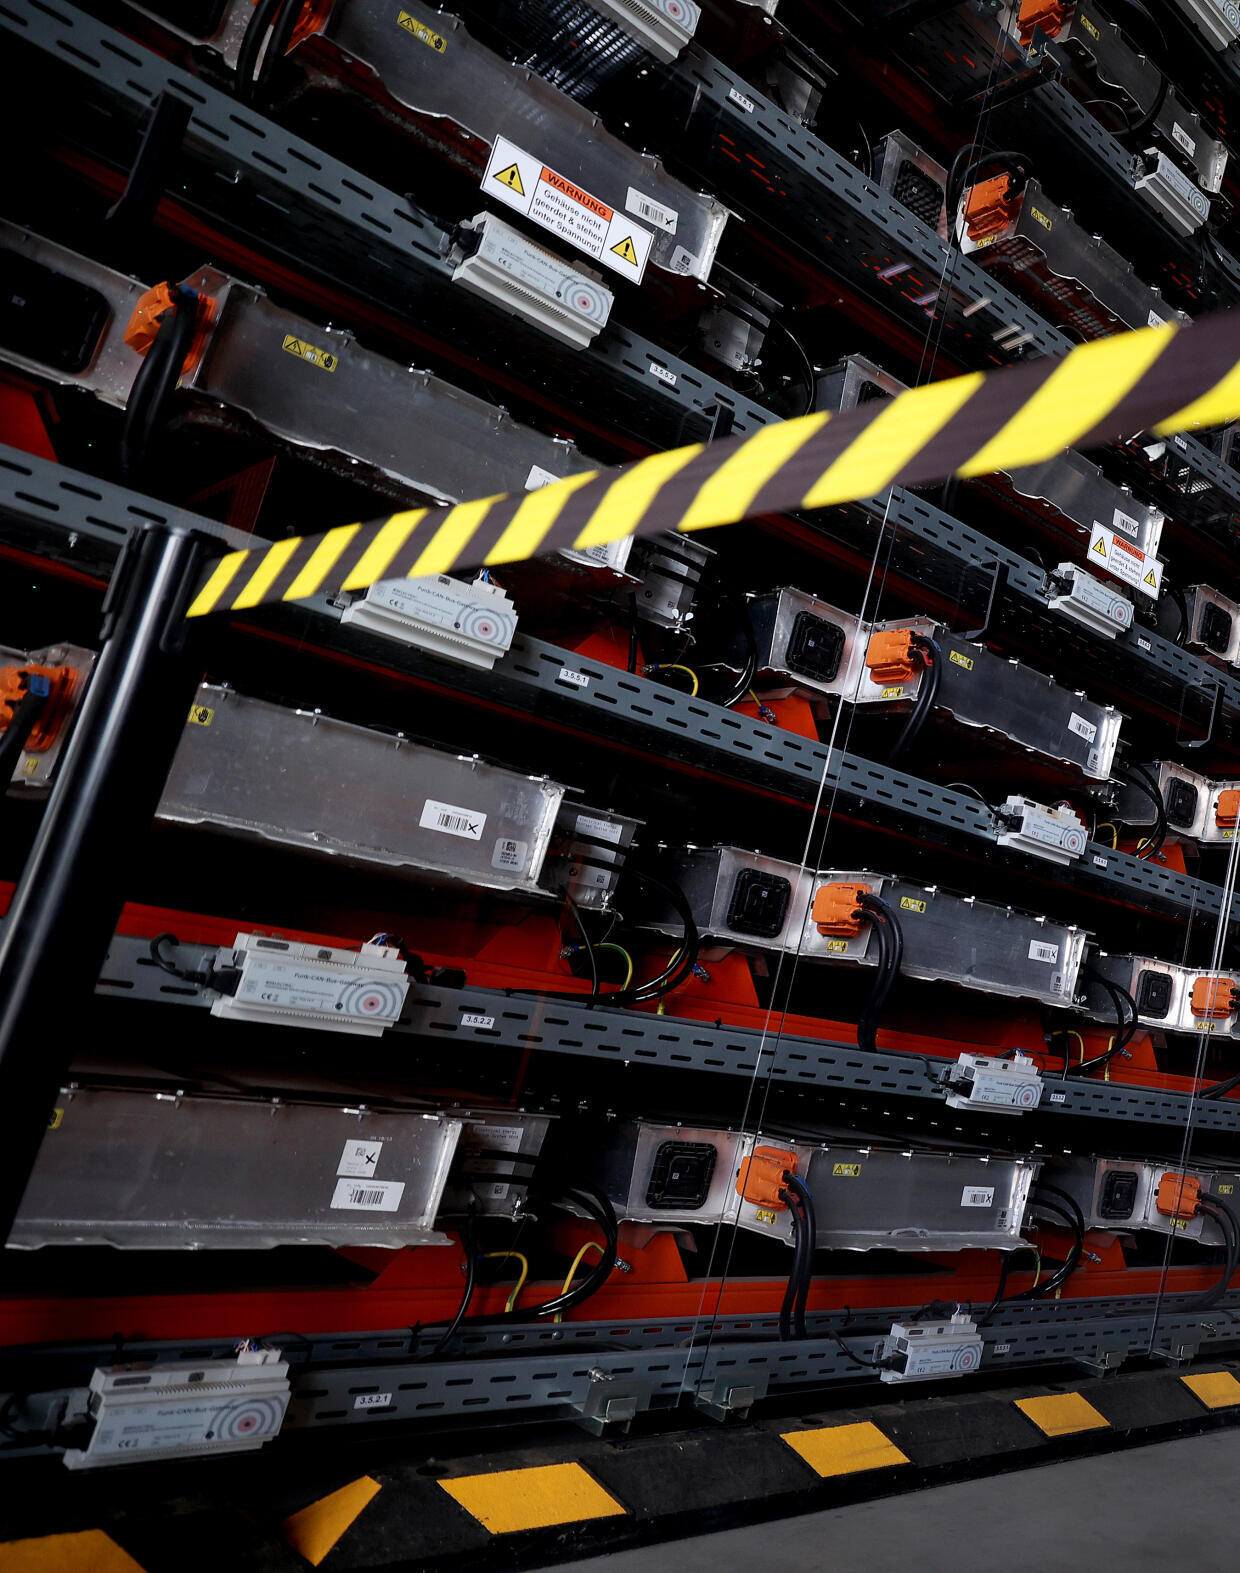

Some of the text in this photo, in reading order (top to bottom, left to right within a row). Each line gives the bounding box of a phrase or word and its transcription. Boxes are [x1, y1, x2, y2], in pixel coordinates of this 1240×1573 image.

[548, 173, 607, 217] WARNUNG
[535, 197, 603, 243] geerdet & stehen
[543, 189, 601, 231] Gehäuse nicht
[532, 208, 600, 253] unter Spannung!
[654, 365, 675, 380] 3.5.5.2
[563, 670, 586, 684] 3.5.5.1
[465, 1015, 492, 1026] 3.5.2.2
[360, 1394, 388, 1405] 3.5.2.1
